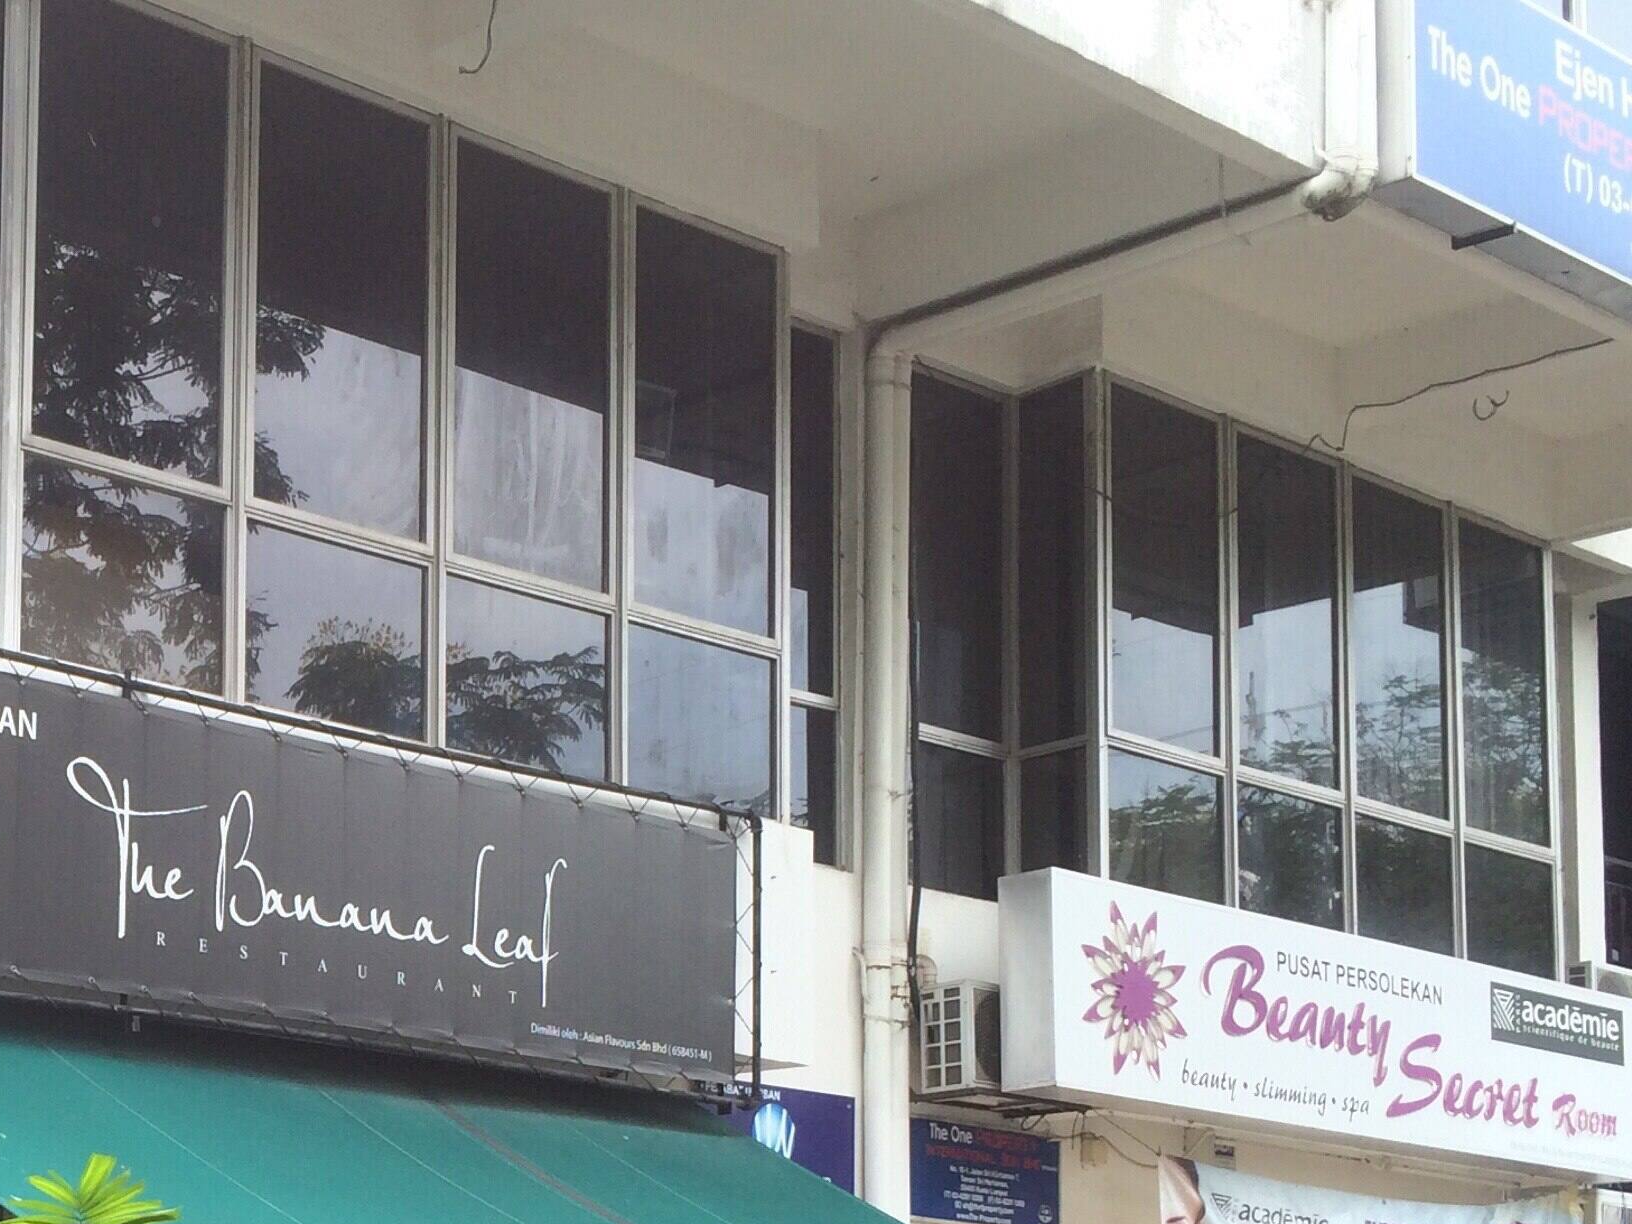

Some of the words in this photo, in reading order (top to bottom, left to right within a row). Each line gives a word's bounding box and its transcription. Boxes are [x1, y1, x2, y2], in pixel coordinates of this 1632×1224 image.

[1428, 24, 1473, 88] The
[1479, 55, 1531, 119] One
[1555, 38, 1614, 111] Ejen
[1563, 152, 1593, 205] (T)
[67, 756, 208, 939] The
[215, 790, 449, 945] Banana
[462, 845, 567, 1007] Leaf
[156, 931, 519, 1005] RESTAURANT
[1276, 951, 1331, 984] PUSAT
[1336, 965, 1444, 1006] PERSOLEKAN
[636, 1039, 651, 1051] Sdn
[652, 1042, 667, 1054] Bhd
[1202, 944, 1392, 1088] Beauty
[1181, 1059, 1237, 1101] beauty
[1253, 1077, 1327, 1117] slimming
[1341, 1098, 1369, 1122] spa
[1386, 1033, 1540, 1129] Secret
[1552, 1093, 1617, 1137] Room
[929, 1122, 948, 1141] The
[950, 1125, 973, 1144] One
